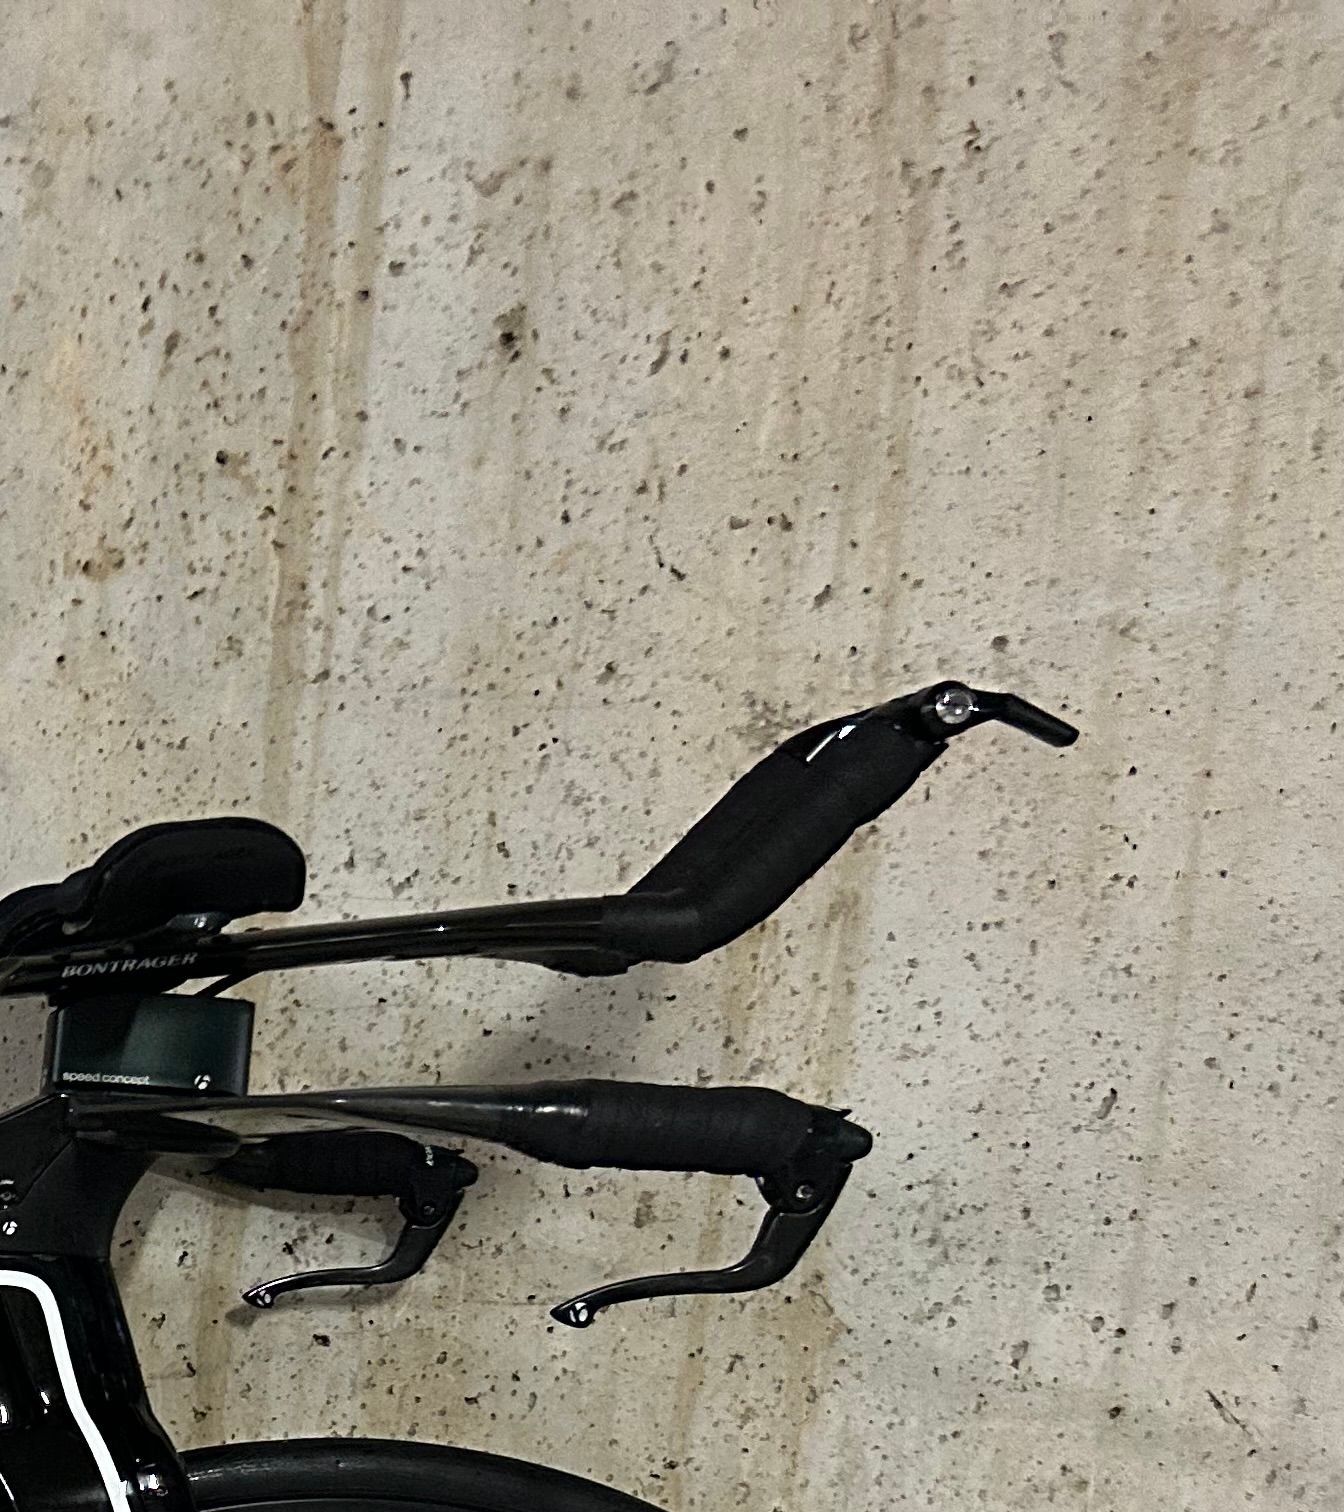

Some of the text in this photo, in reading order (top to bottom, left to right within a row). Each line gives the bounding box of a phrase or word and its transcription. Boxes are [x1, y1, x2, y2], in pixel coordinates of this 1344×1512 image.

[62, 952, 199, 978] BONTRAGER
[63, 1072, 150, 1086] speed concept
